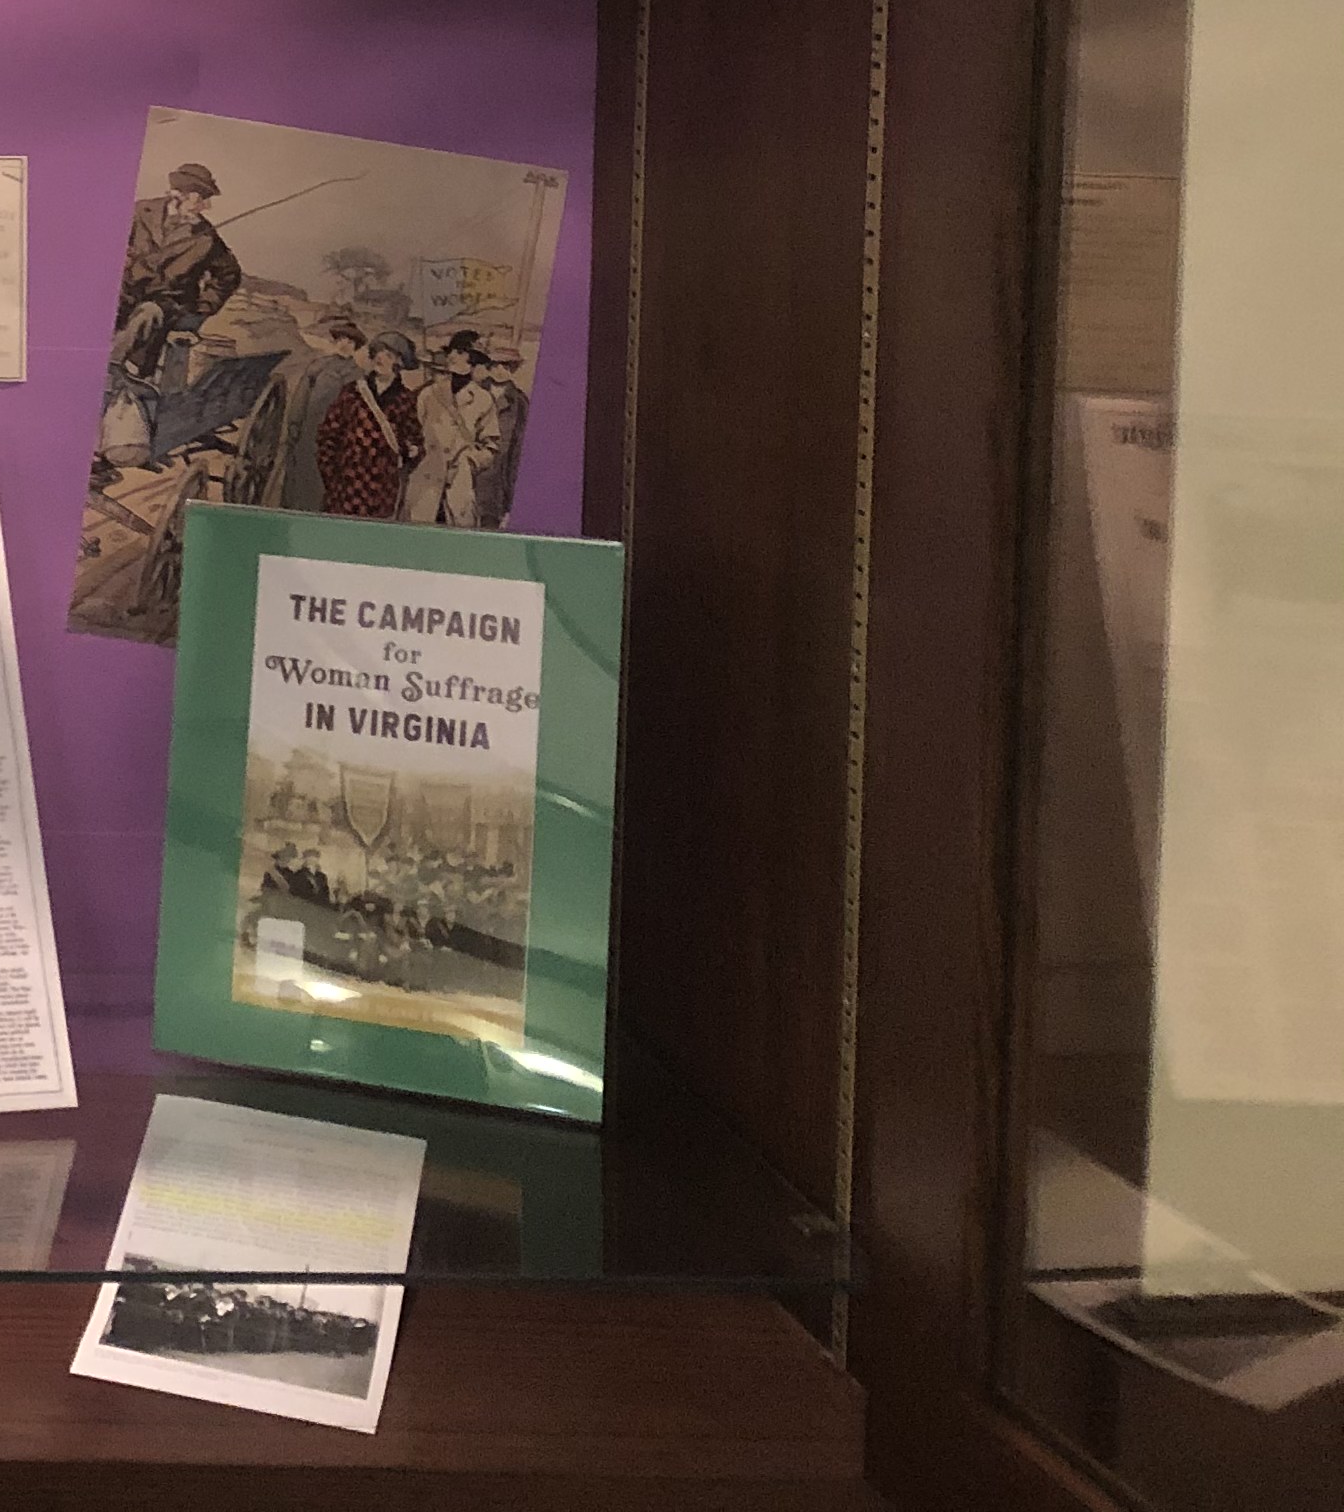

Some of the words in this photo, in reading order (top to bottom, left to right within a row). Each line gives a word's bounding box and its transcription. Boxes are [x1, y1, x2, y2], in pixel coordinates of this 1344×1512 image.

[289, 593, 347, 626] THE
[357, 601, 520, 645] CAMPAIGN
[382, 641, 422, 664] for
[264, 655, 390, 692] Woman
[401, 671, 540, 714] Suffrage
[305, 702, 336, 731] IN
[348, 707, 490, 750] VIRGINIA
